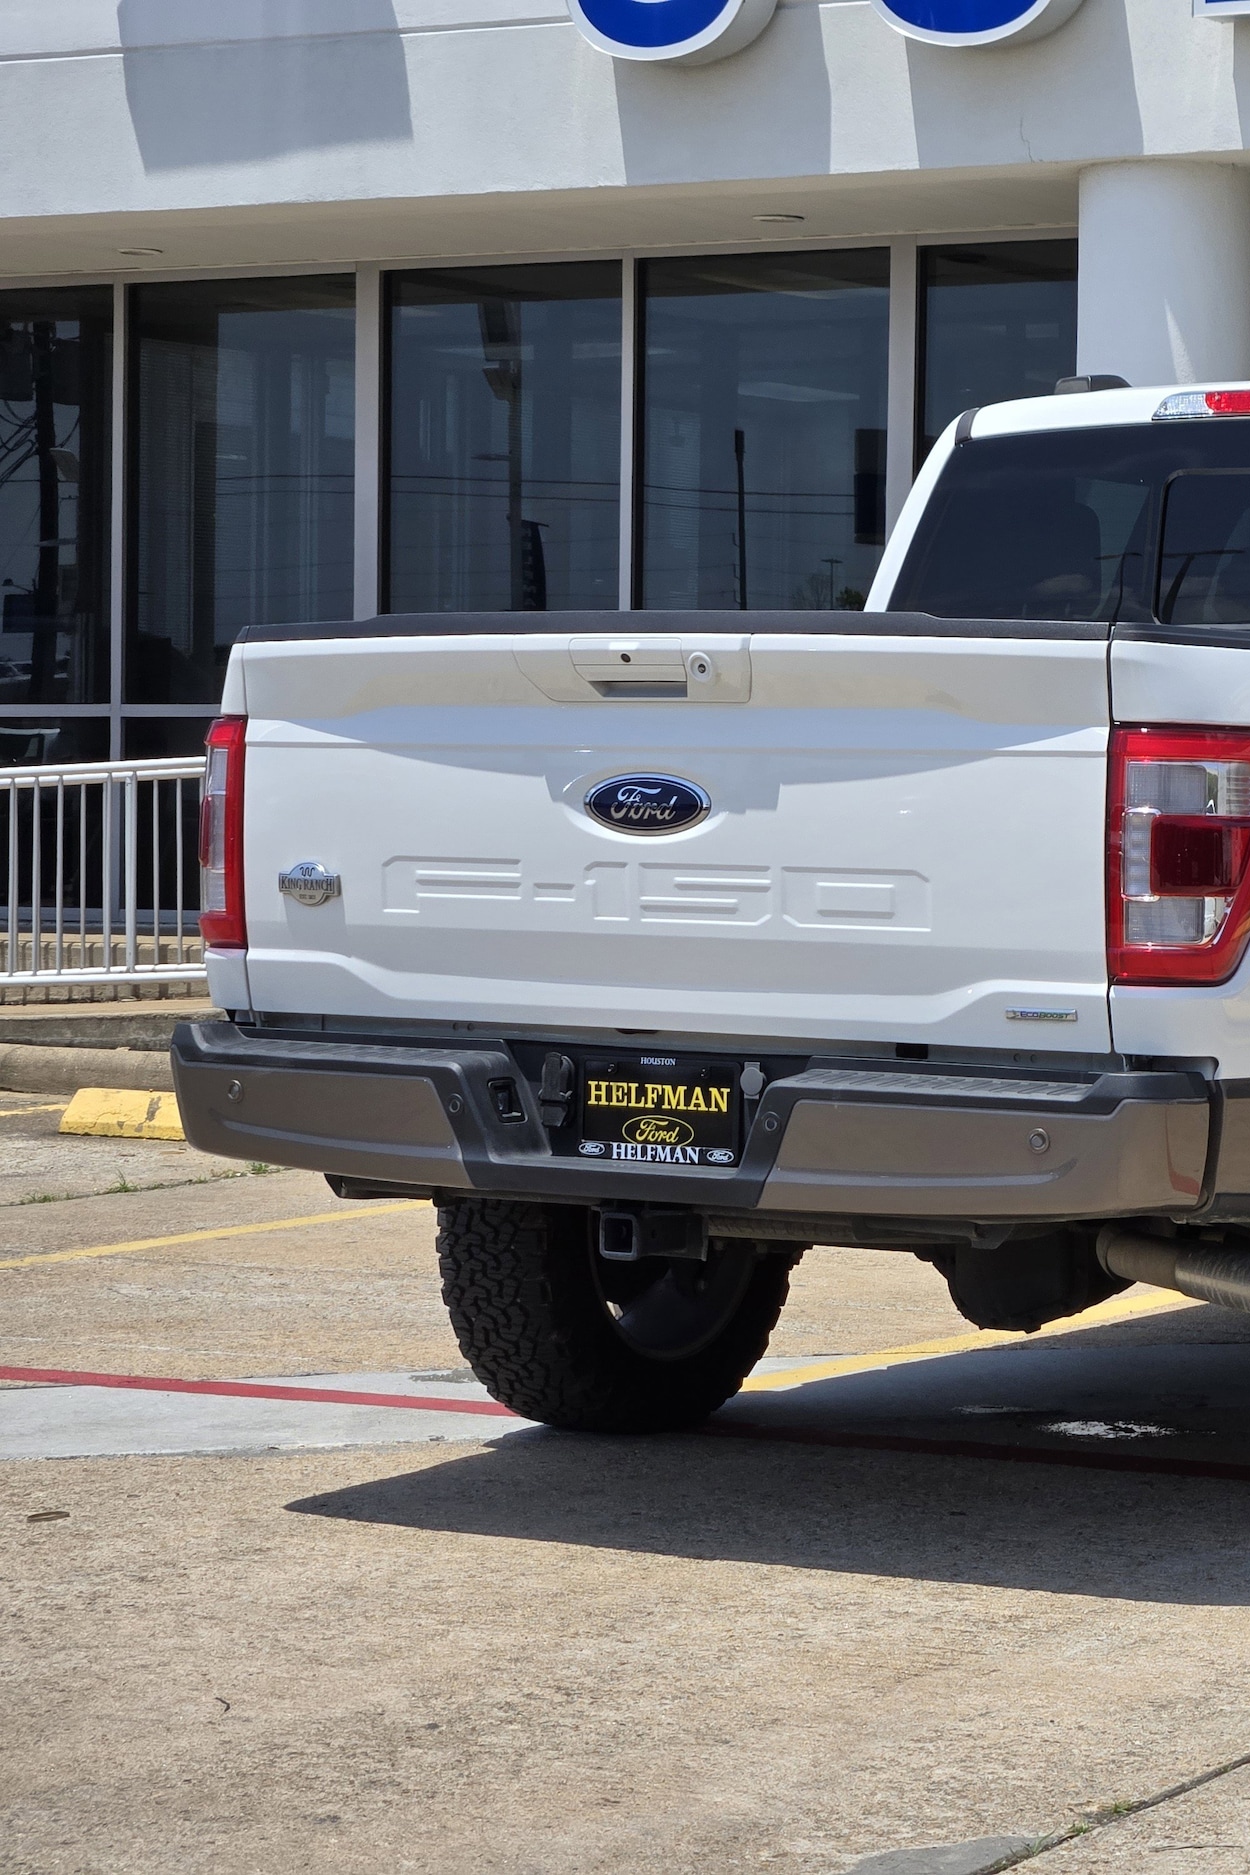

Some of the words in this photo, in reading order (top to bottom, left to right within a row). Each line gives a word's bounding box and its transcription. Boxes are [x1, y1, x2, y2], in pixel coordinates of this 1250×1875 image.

[610, 785, 678, 820] Ford
[281, 876, 302, 890] KING
[303, 878, 333, 891] RANCH
[382, 855, 932, 932] F-150
[640, 1056, 676, 1066] HOUSTON
[587, 1080, 731, 1112] HELFMAN
[635, 1118, 680, 1144] Ford
[581, 1143, 603, 1154] Ford
[610, 1142, 700, 1164] HELFMAN
[709, 1151, 731, 1162] Ford
